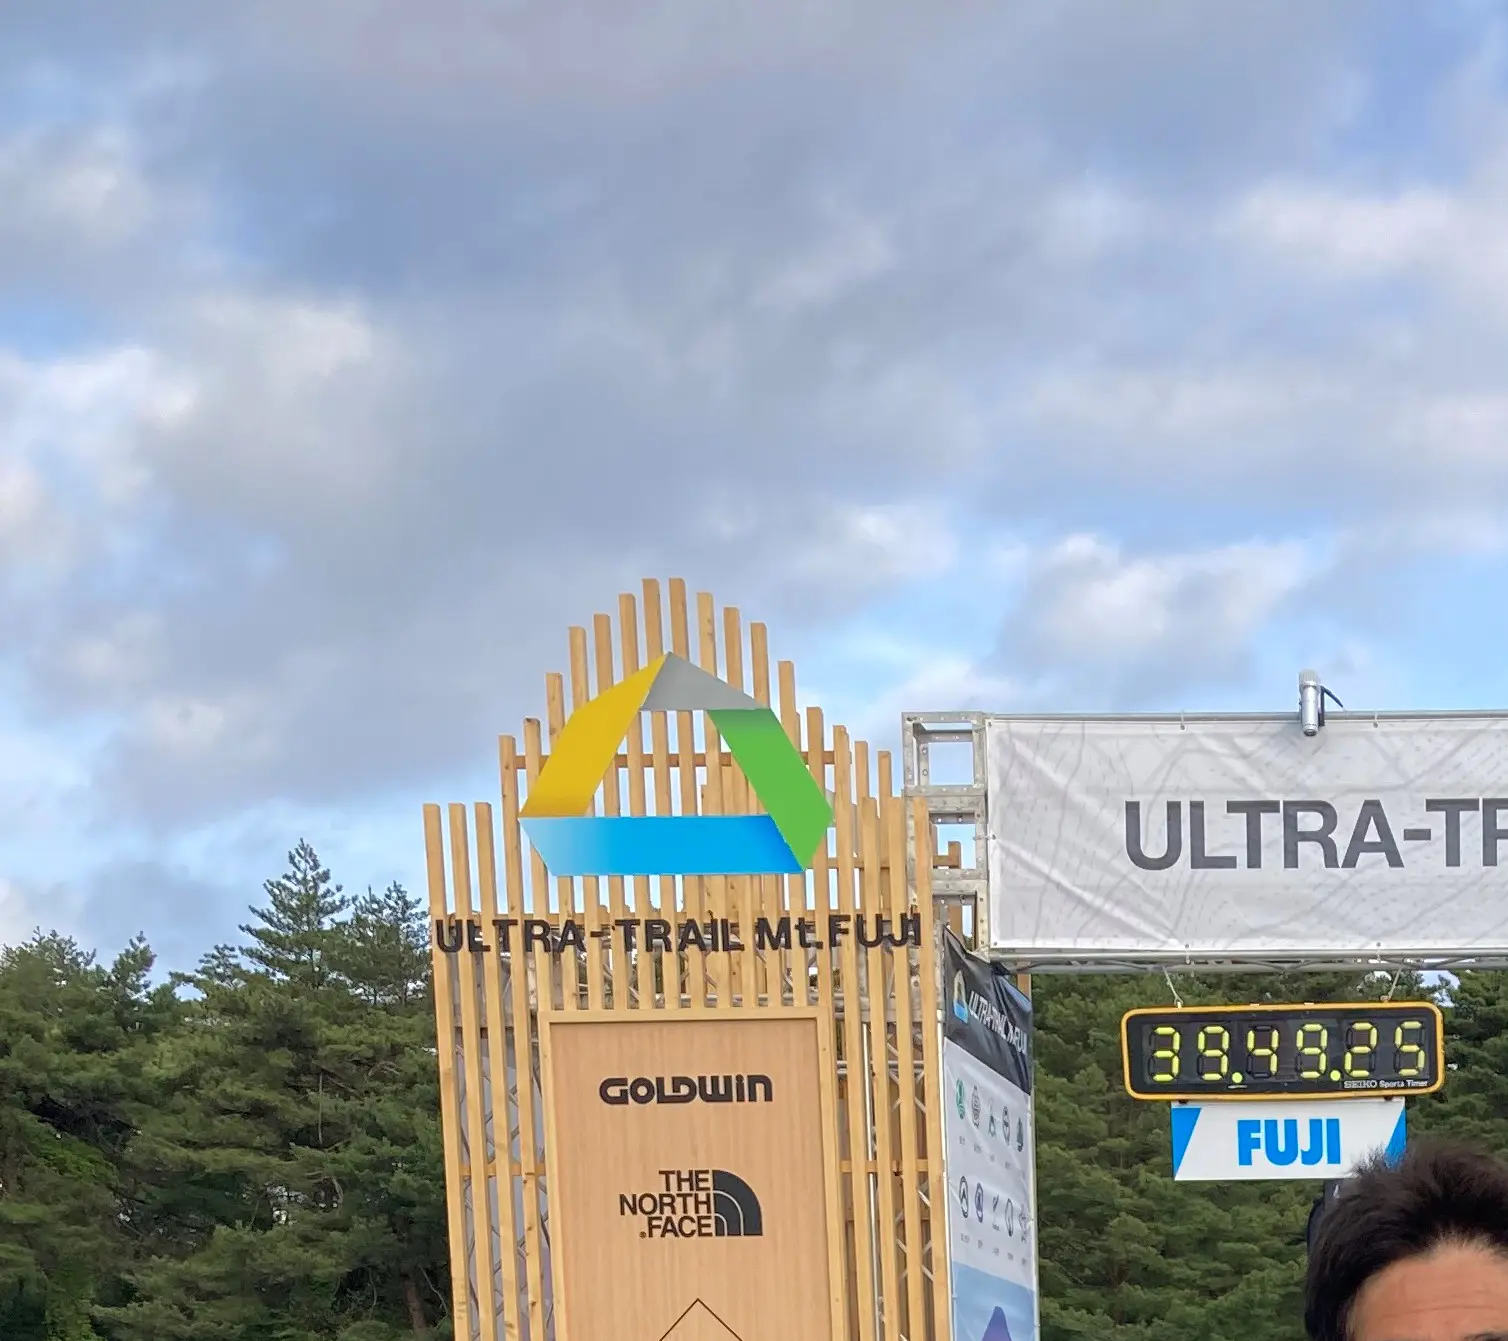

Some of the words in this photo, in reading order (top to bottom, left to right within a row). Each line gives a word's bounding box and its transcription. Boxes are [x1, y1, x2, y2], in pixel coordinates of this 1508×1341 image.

[435, 915, 745, 953] ULTRA-TRAIL
[756, 912, 922, 950] Mt.FUJI
[1343, 1080, 1378, 1089] SEIKO
[1379, 1080, 1405, 1089] Sports
[1237, 1118, 1341, 1166] FUJI
[658, 1169, 713, 1192] THE
[619, 1192, 712, 1216] NORTH
